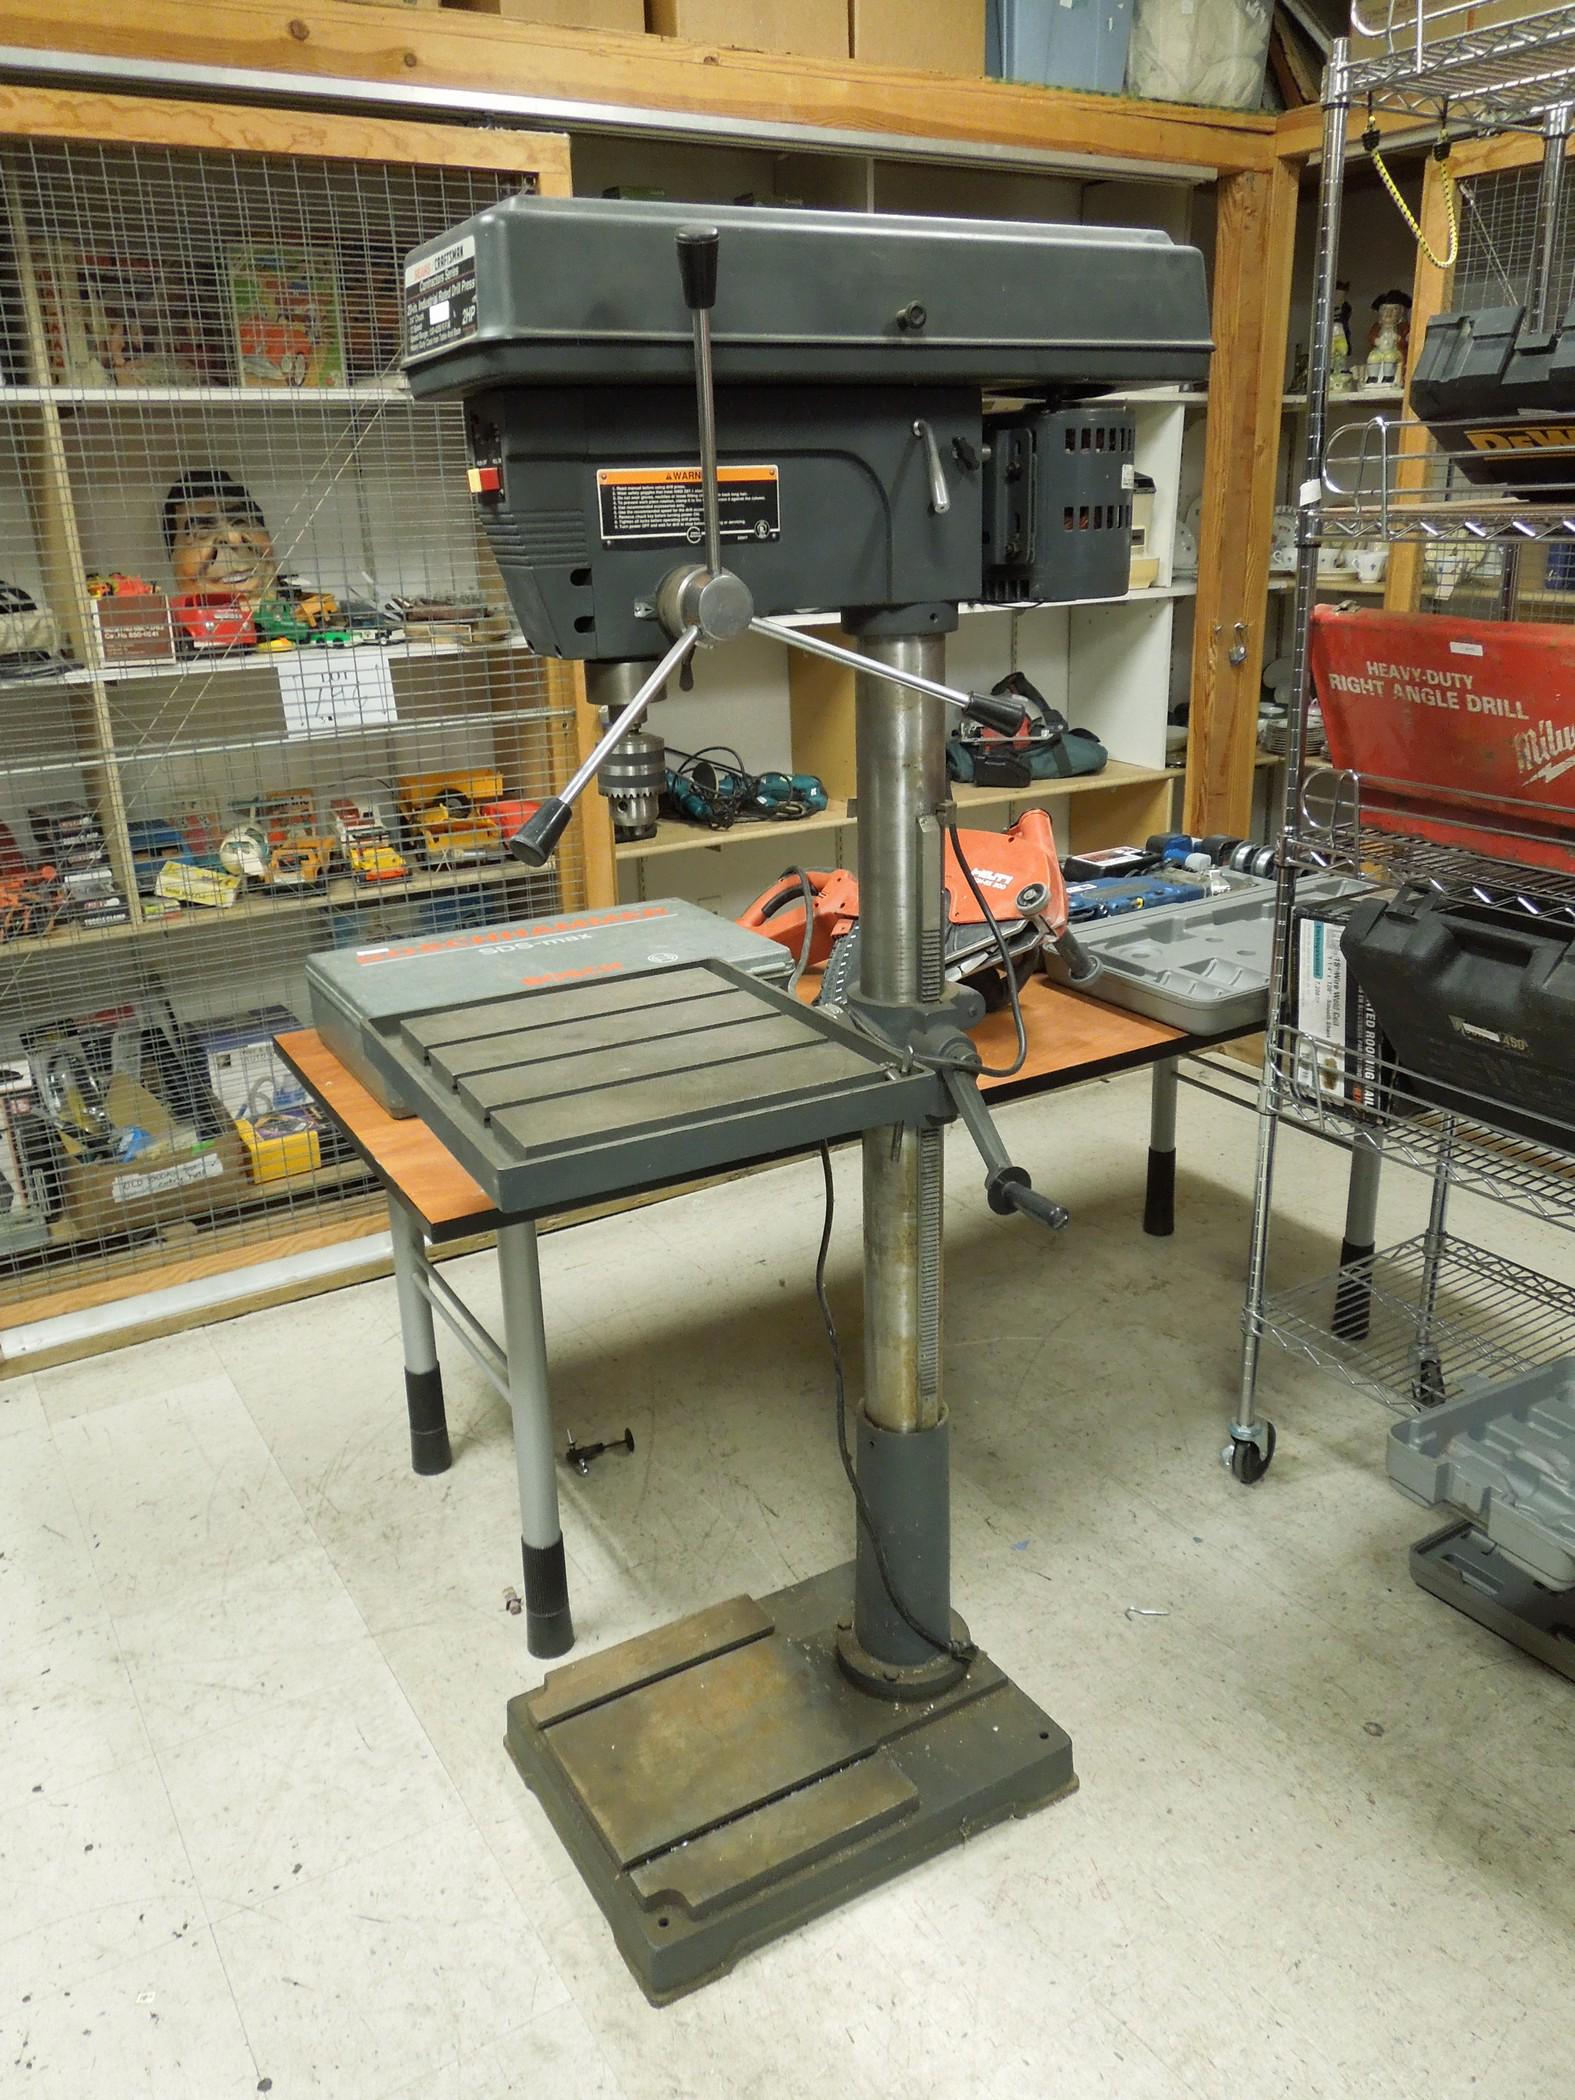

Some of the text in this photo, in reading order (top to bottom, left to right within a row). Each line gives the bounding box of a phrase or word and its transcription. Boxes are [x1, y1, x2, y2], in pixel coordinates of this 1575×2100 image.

[434, 245, 464, 270] CRAFTSMAN
[445, 266, 459, 280] Series
[461, 278, 476, 292] Press
[462, 304, 476, 326] 2HP
[674, 472, 702, 480] WARN
[1366, 661, 1474, 690] HEAVY-DUTY
[1328, 673, 1530, 720] RIGHT ANGLE DRILL
[971, 868, 1014, 885] HILTI
[478, 932, 592, 956] SDS-max
